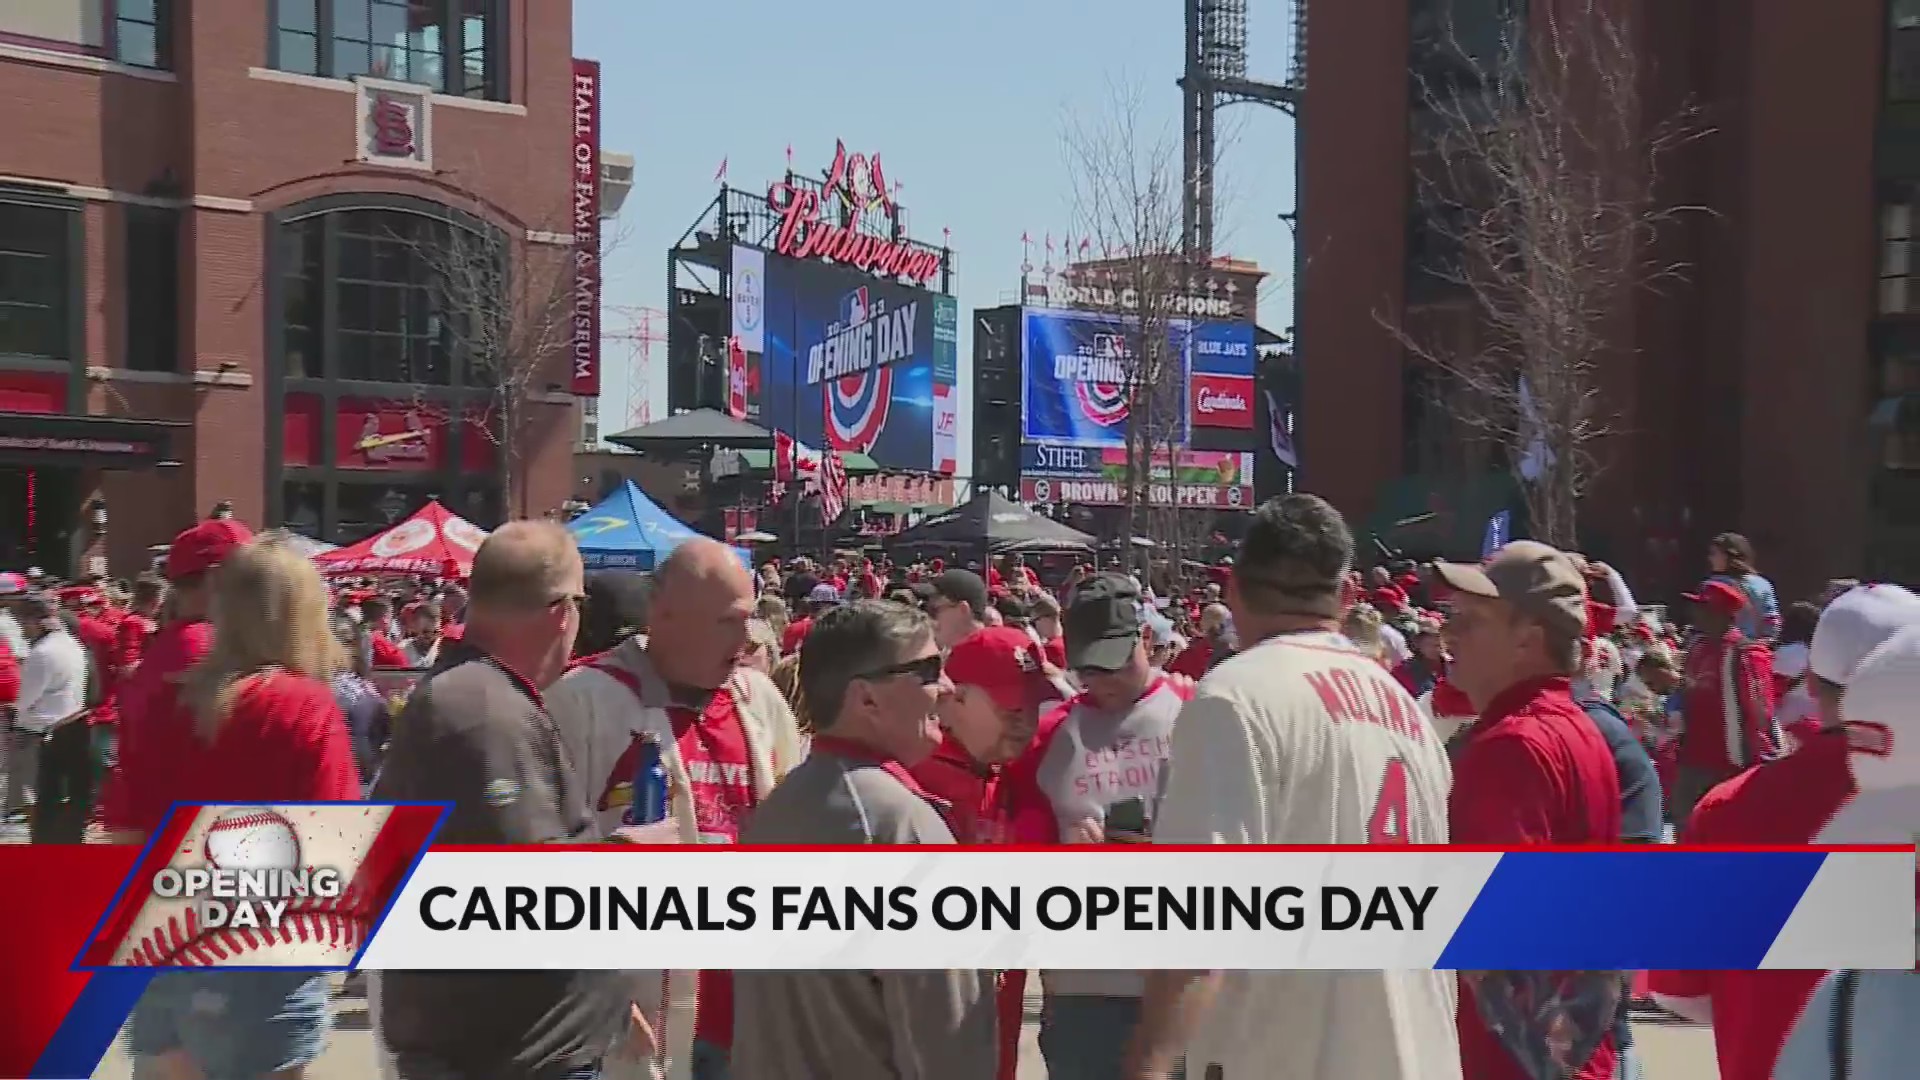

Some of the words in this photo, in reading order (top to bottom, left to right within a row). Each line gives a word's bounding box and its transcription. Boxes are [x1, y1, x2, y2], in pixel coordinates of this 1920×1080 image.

[574, 74, 593, 138] HALL
[574, 142, 592, 175] OF
[574, 180, 592, 242] FAME
[768, 182, 940, 283] Budweiser
[574, 250, 592, 268] &
[1048, 282, 1117, 306] WORLD
[574, 276, 592, 379] MUSEUM
[807, 321, 873, 384] OPENING
[877, 301, 917, 364] DAY
[1198, 341, 1222, 355] BLUE
[1223, 343, 1248, 357] JAYS
[1197, 386, 1248, 414] Cardinals
[1036, 442, 1089, 468] STIFEL
[1061, 481, 1119, 503] BROWN
[1302, 667, 1427, 748] MOLINA
[1366, 757, 1410, 844] 4
